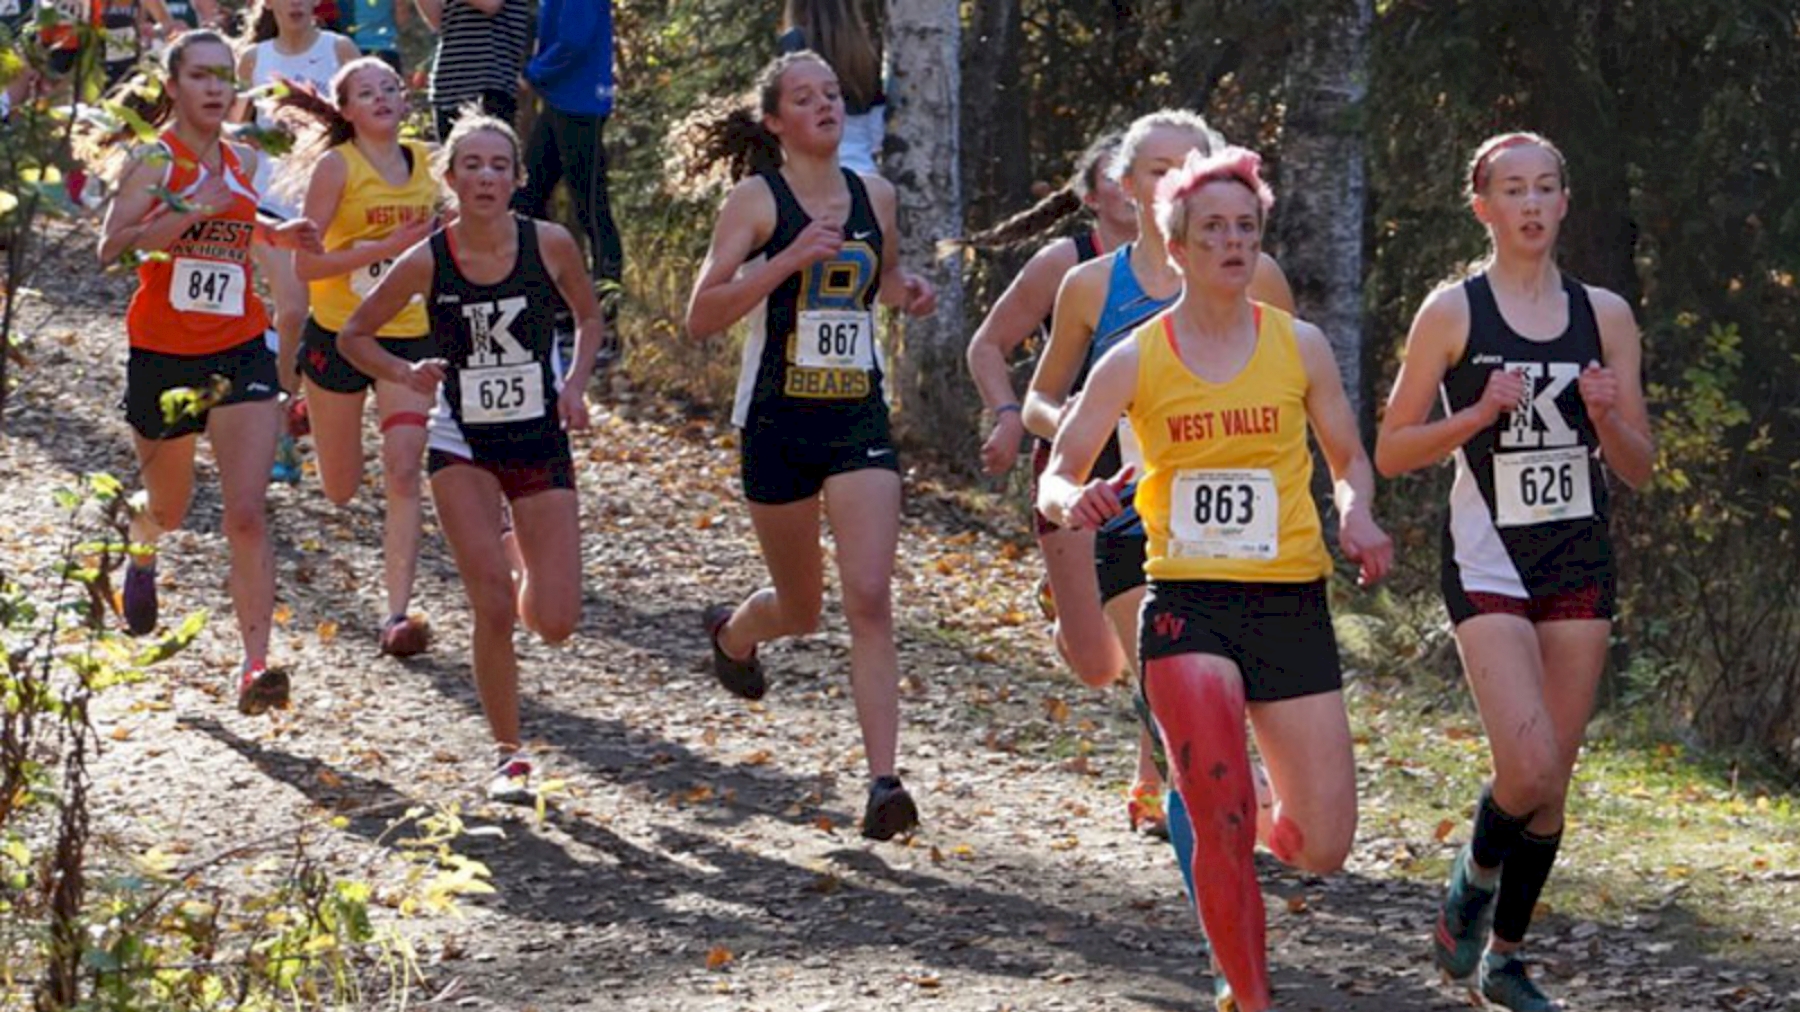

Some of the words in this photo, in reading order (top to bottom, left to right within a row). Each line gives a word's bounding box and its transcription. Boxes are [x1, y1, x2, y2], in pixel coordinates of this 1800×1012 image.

[188, 270, 231, 302] 847
[818, 323, 860, 356] 867
[479, 377, 525, 410] 625
[786, 368, 870, 397] BEARS
[1167, 411, 1215, 442] WEST
[1221, 406, 1280, 437] VALLEY
[1520, 463, 1573, 506] 626
[1195, 484, 1254, 525] 863
